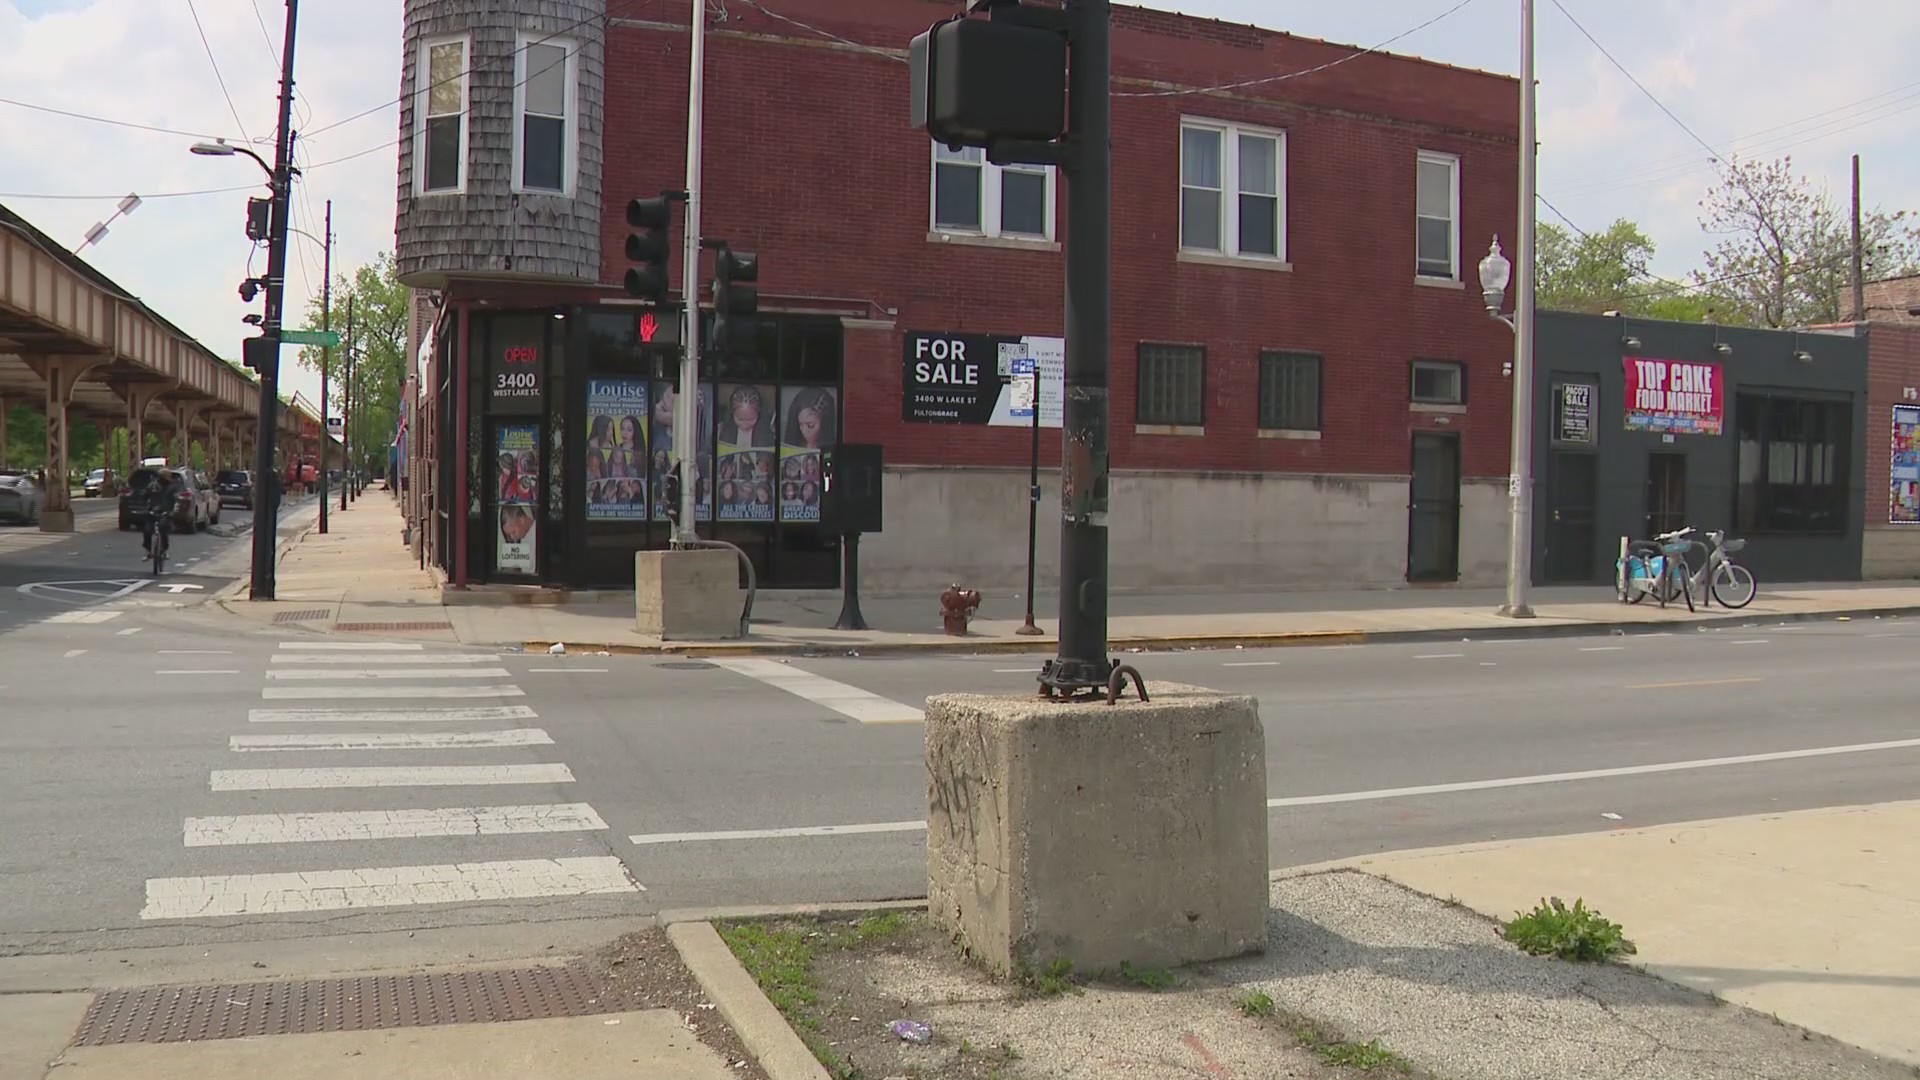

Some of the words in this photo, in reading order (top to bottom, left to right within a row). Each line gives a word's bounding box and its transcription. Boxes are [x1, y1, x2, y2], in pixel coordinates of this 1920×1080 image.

[504, 347, 537, 362] OPEN
[915, 338, 966, 361] FOR
[915, 362, 979, 385] SALE
[1634, 360, 1667, 390] TOP
[1670, 363, 1713, 393] CAKE
[497, 373, 536, 388] 3400
[493, 389, 512, 397] WEST
[530, 388, 541, 396] ST.
[591, 381, 645, 397] Louise
[914, 395, 935, 403] 3400
[945, 396, 965, 404] LAKE
[1566, 395, 1588, 406] SALE
[1635, 388, 1665, 410] FOOD
[1667, 391, 1712, 413] MARKET
[914, 409, 959, 417] FULTONGRACE
[504, 428, 534, 438] Louise
[720, 510, 743, 518] BRAIDS
[784, 511, 818, 519] DISCOU
